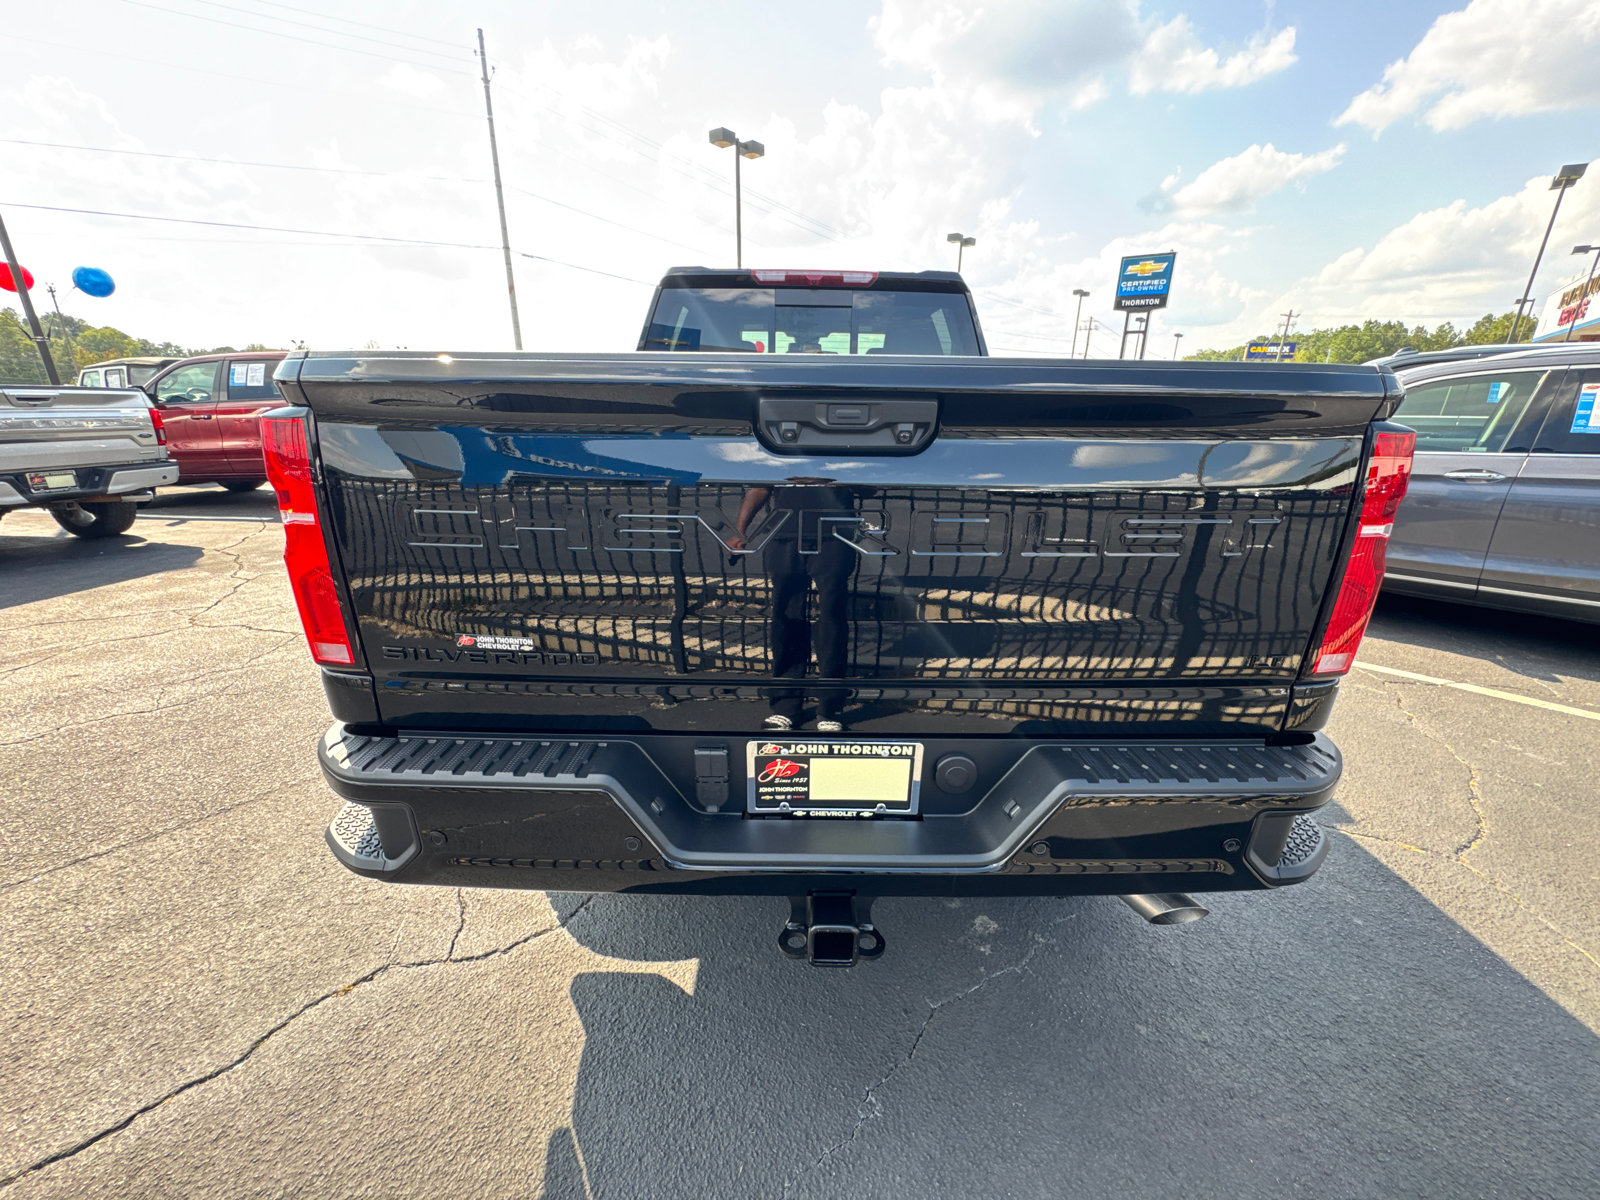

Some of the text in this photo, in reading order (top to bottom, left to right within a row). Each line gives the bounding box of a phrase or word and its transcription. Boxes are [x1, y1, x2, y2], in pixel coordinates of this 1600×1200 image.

[1121, 279, 1166, 288] CERTIFIED
[1121, 298, 1160, 307] THORNTON
[397, 500, 1284, 558] CHEVROLET
[477, 636, 533, 645] JOHN THORNTON
[382, 646, 600, 666] SILVERADO
[788, 744, 827, 753] JOHN
[832, 745, 912, 755] THORNTON
